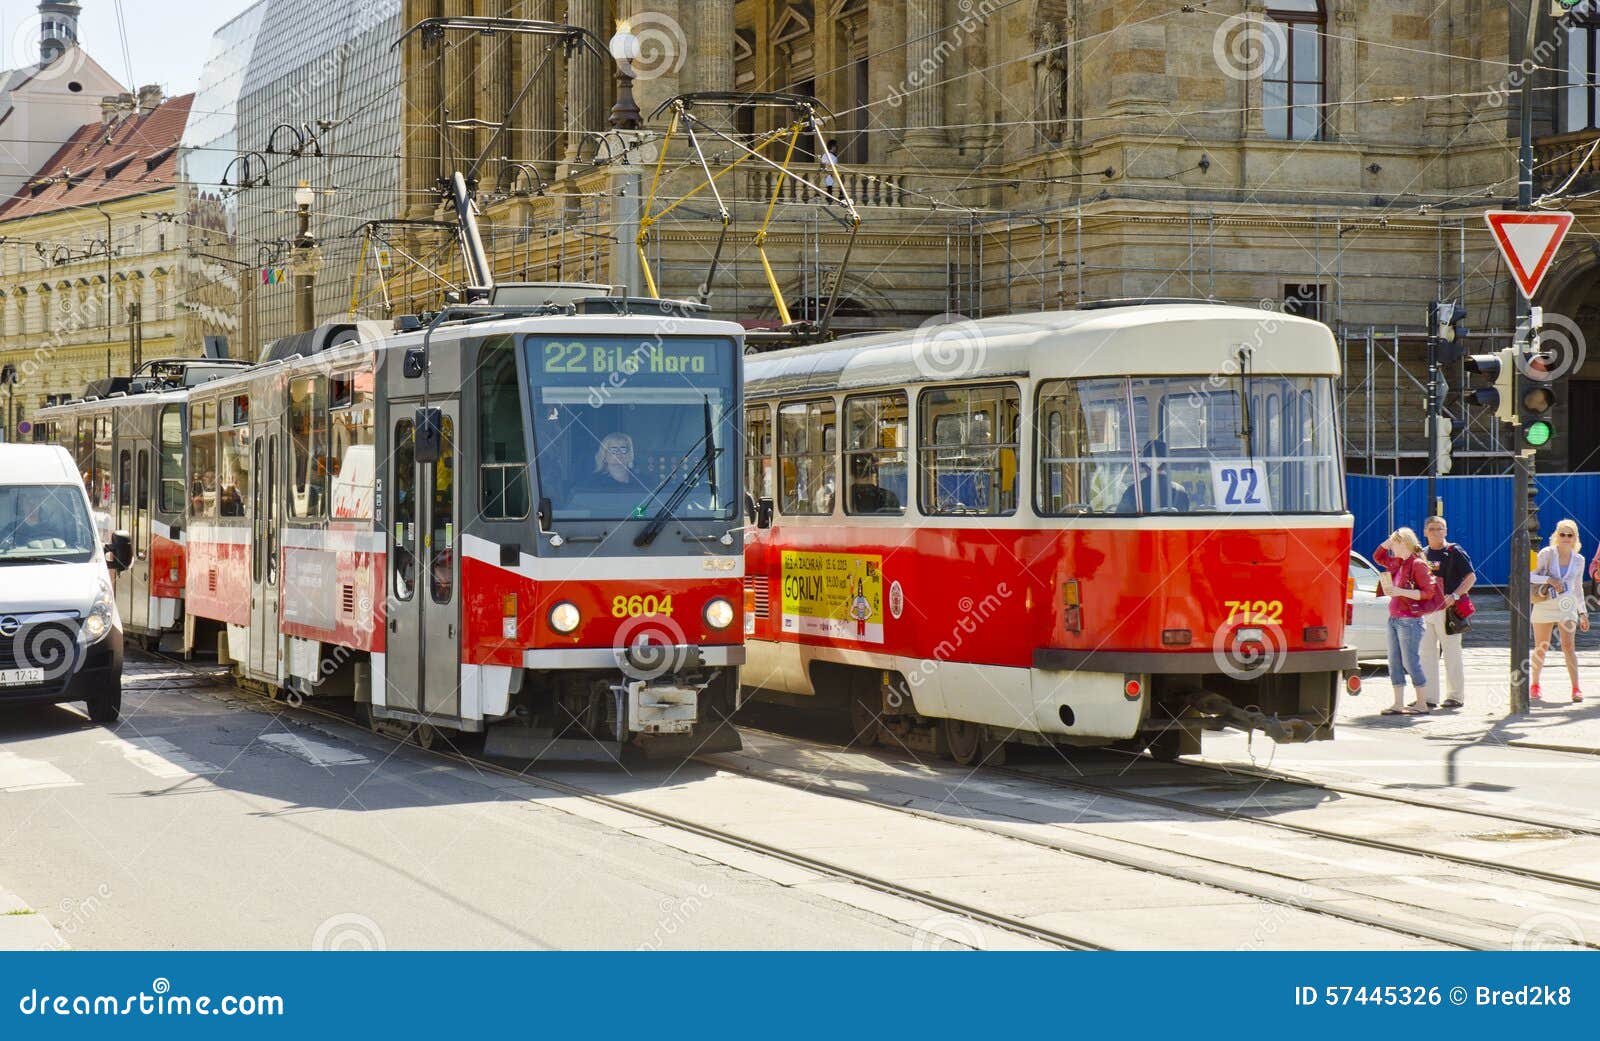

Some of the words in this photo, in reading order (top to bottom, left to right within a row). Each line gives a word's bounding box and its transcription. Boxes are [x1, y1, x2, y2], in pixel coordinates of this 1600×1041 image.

[544, 342, 587, 373] 22
[651, 346, 705, 373] Hora
[1221, 468, 1262, 504] 22
[784, 574, 823, 602] GORILY!
[611, 594, 674, 618] 8604
[1224, 600, 1284, 625] 7122
[15, 670, 39, 681] 1712
